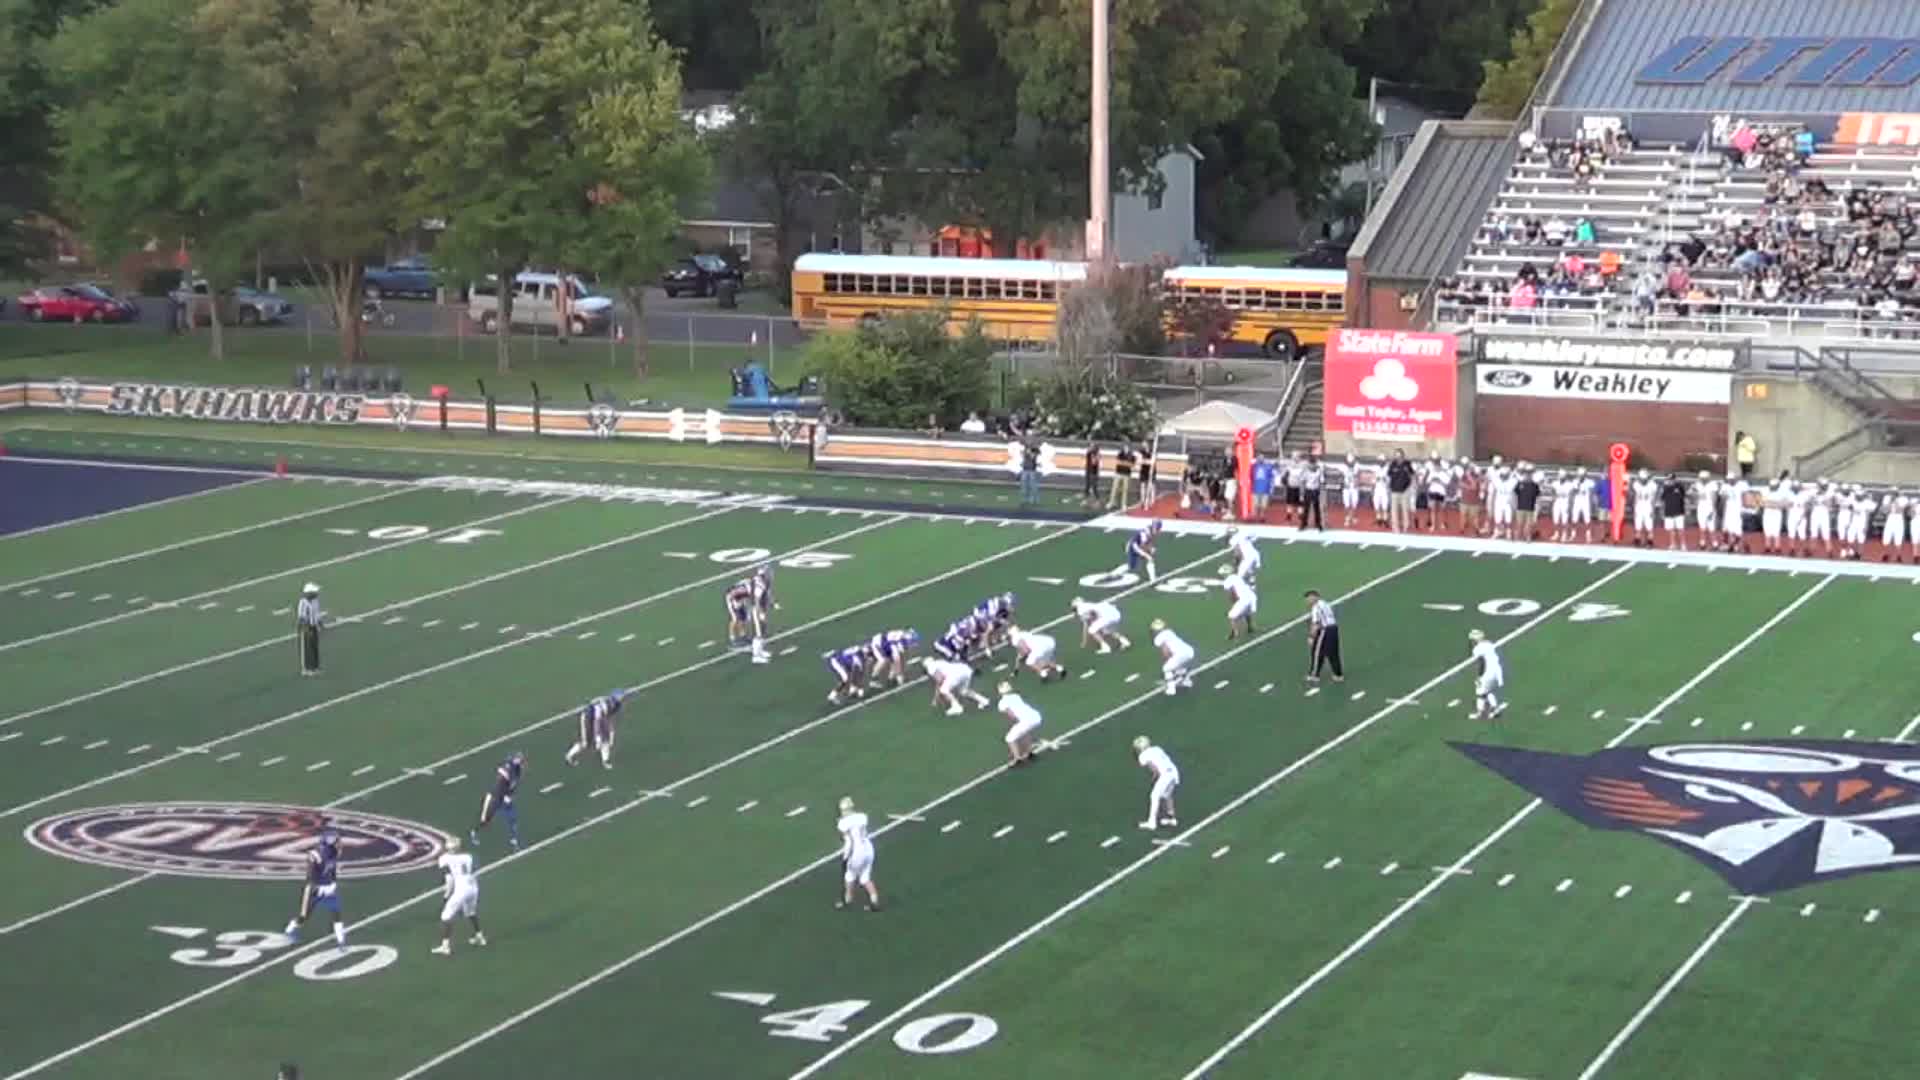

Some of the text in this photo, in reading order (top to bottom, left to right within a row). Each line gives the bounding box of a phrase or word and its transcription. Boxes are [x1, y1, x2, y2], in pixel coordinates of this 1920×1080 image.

[106, 383, 367, 424] SKYHAWKS
[1553, 369, 1671, 399] Weakley
[170, 931, 398, 980] 30
[760, 1000, 998, 1054] 40
